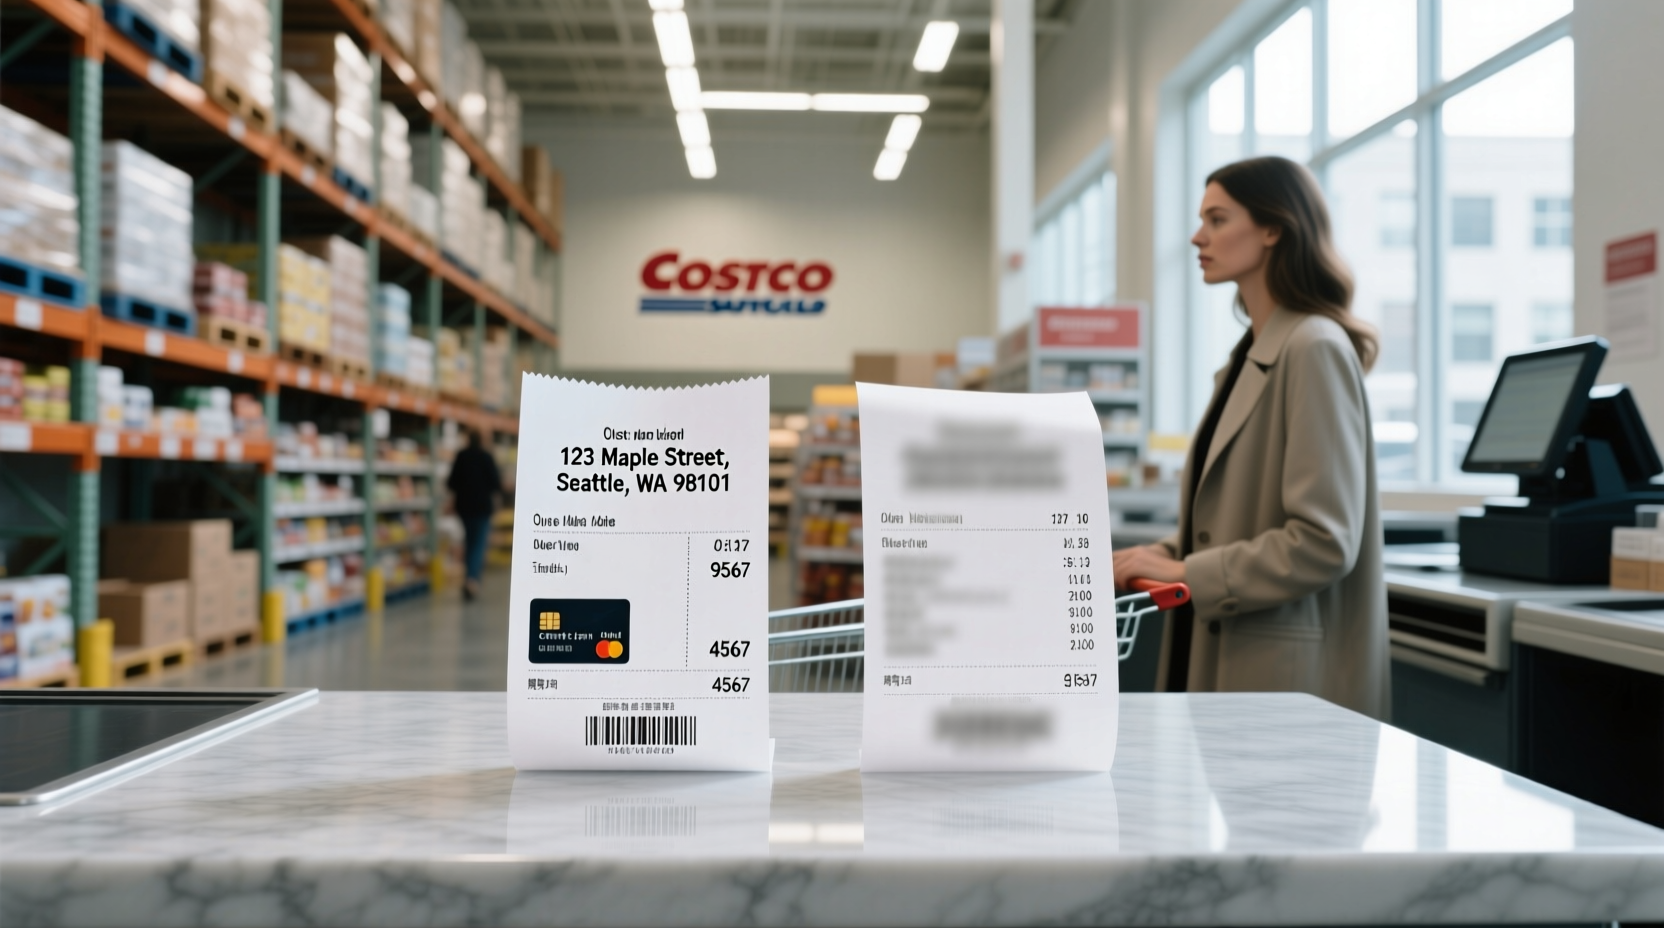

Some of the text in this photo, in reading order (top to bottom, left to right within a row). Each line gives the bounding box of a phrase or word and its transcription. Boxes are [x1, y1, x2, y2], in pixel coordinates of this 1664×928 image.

[560, 446, 730, 471] 123 Maple Street,
[556, 472, 729, 497] Seattle, WA 98101
[710, 561, 751, 579] 9567
[709, 639, 751, 658] 4567
[711, 676, 751, 693] 4567
